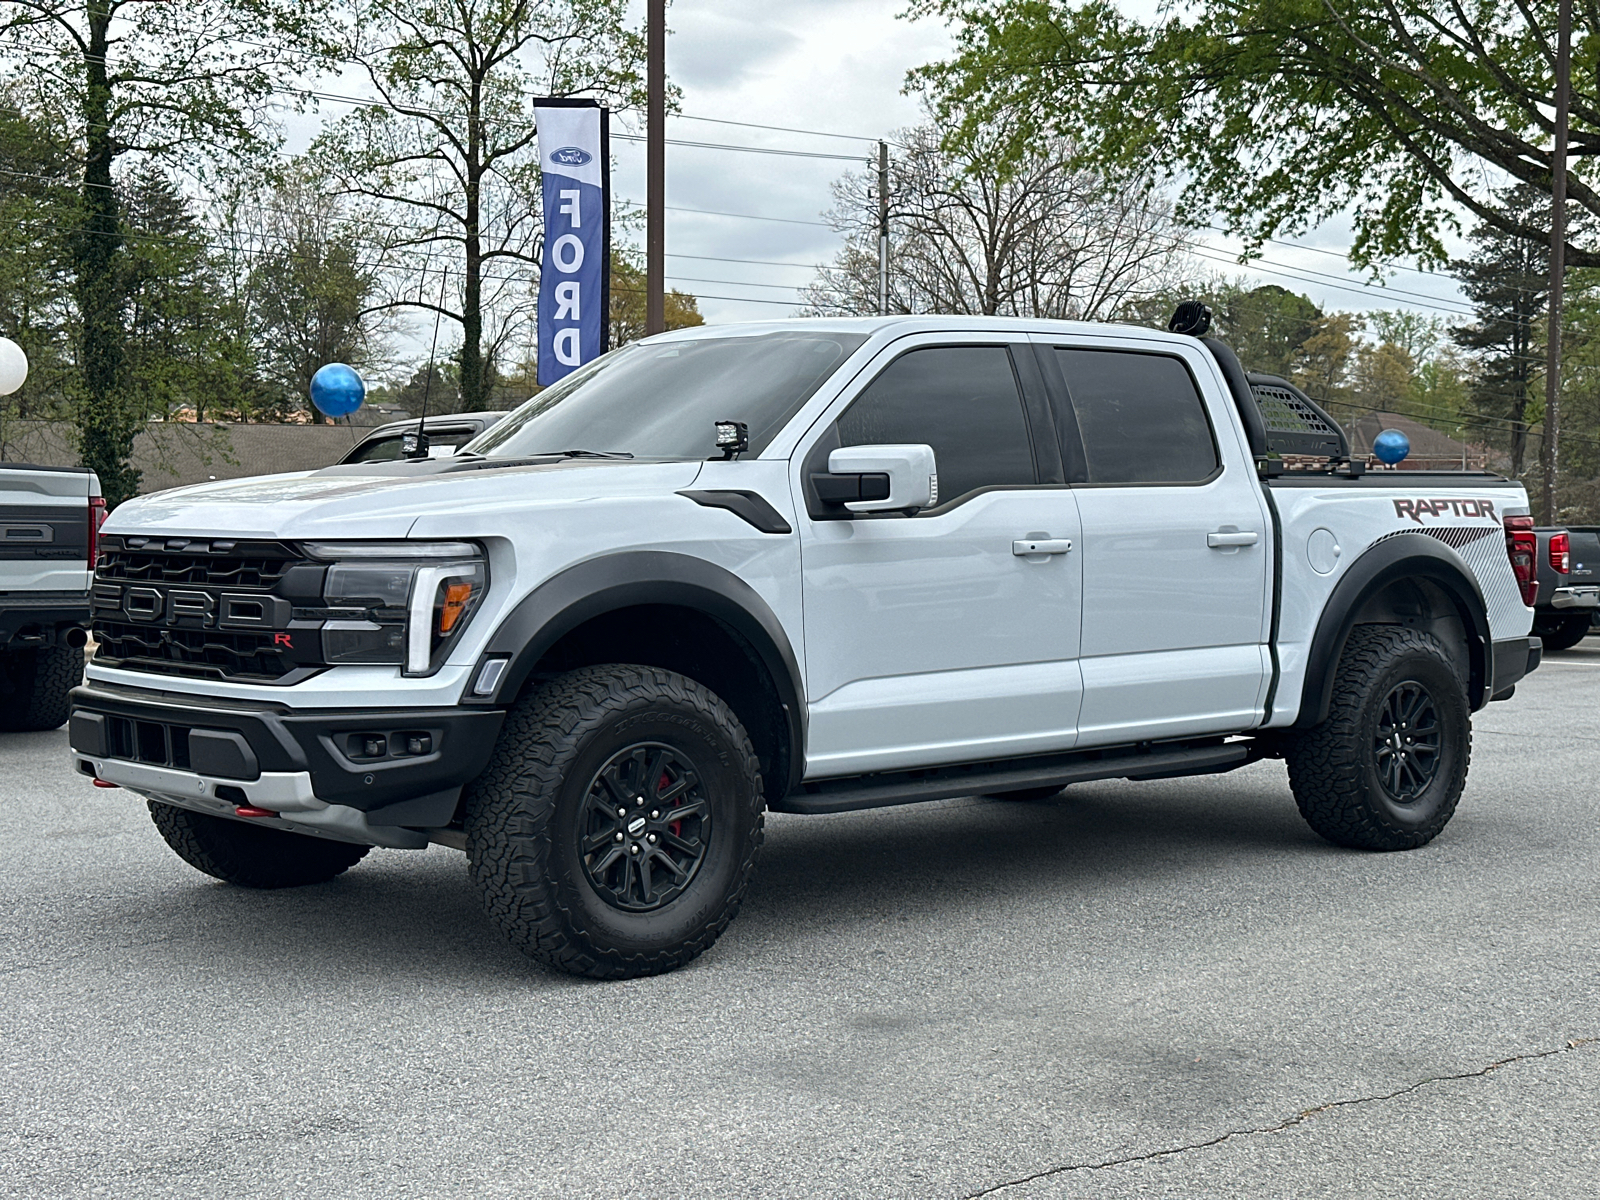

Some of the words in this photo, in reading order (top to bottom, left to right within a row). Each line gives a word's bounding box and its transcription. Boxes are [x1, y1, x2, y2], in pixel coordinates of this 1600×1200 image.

[1392, 499, 1502, 526] RAPTOR
[90, 583, 291, 631] FORD
[274, 633, 294, 649] R
